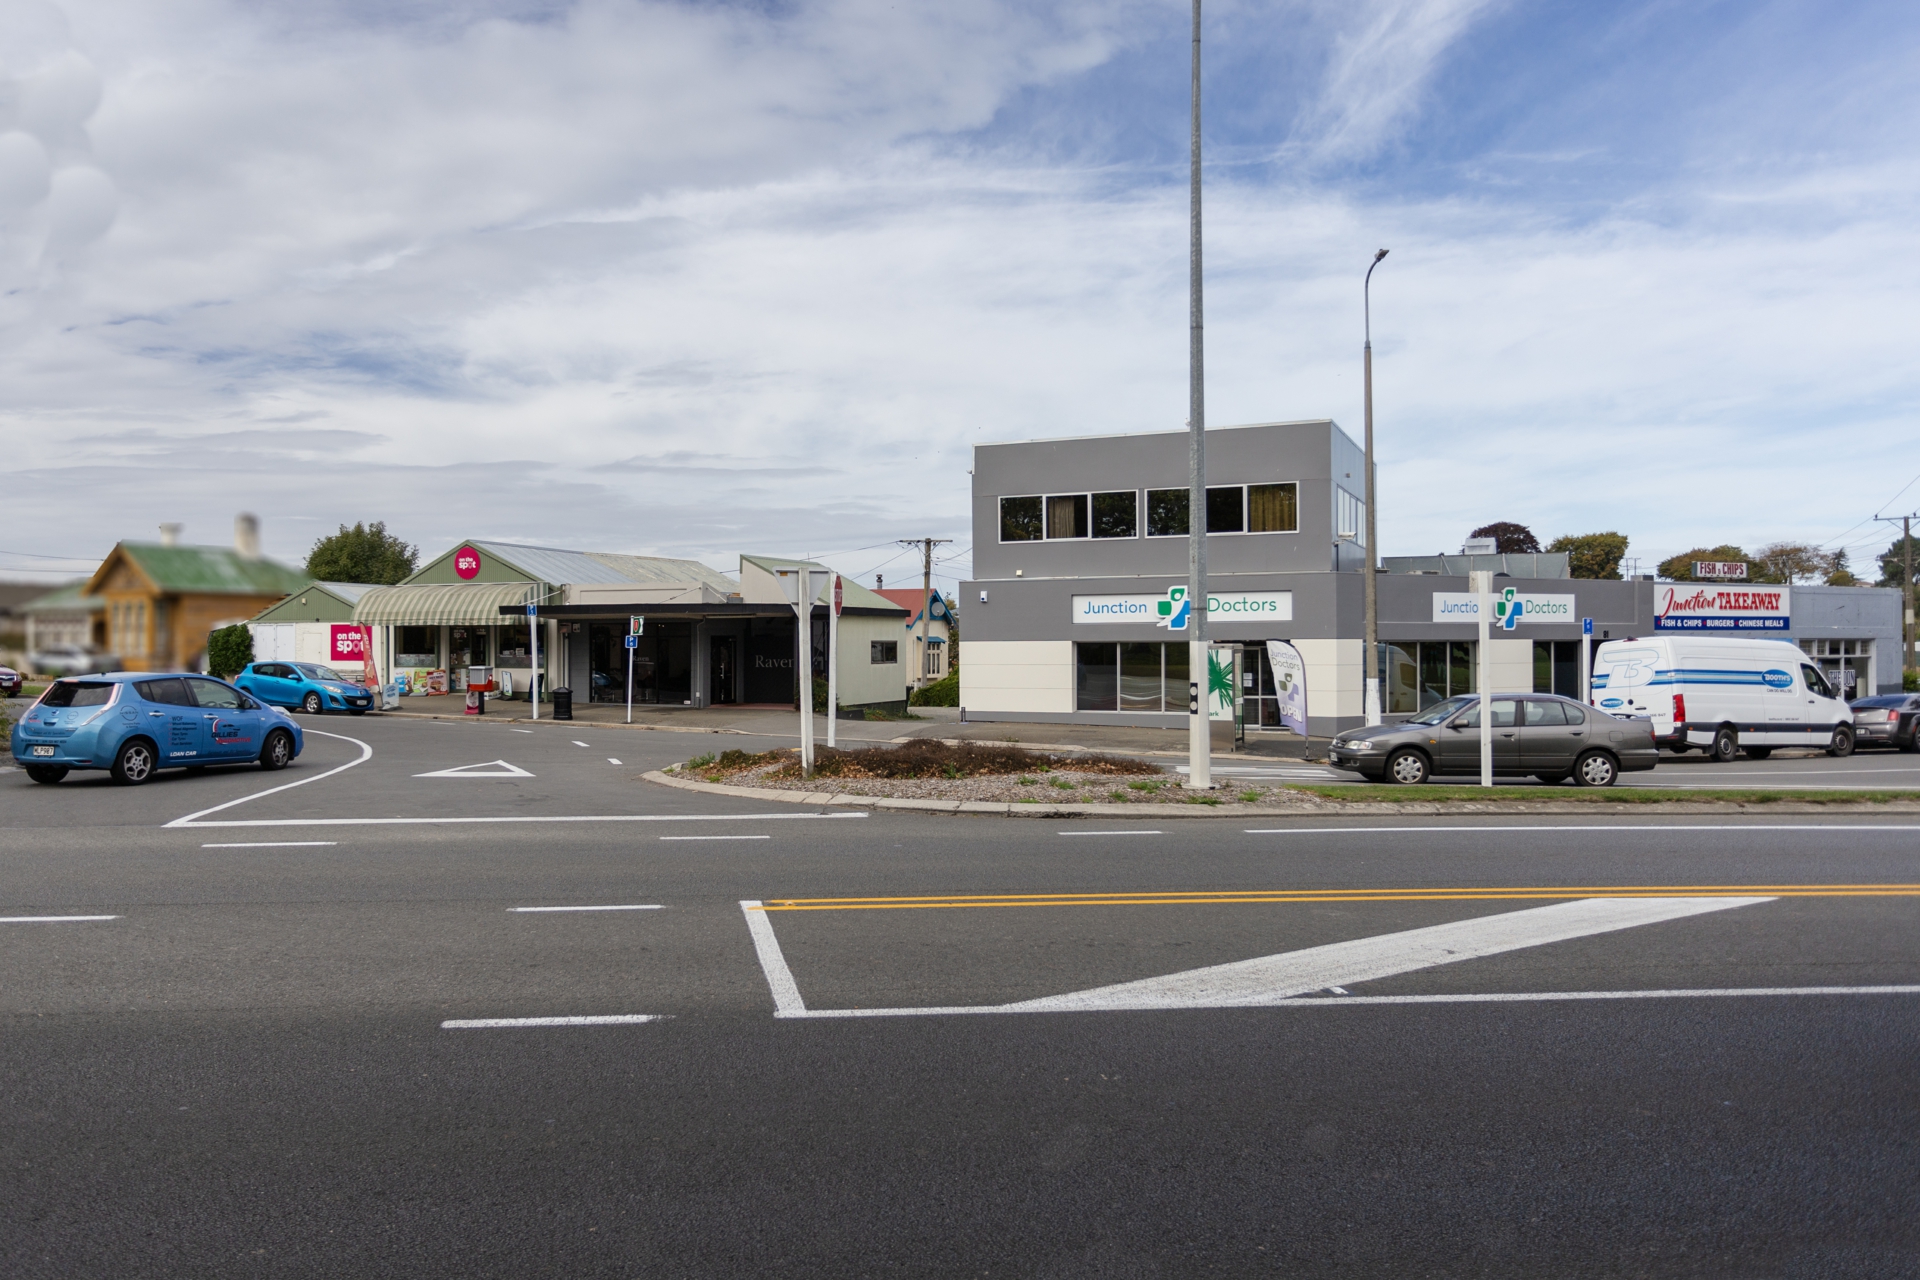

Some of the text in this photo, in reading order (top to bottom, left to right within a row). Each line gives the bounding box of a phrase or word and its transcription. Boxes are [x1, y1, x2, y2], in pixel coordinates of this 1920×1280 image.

[458, 560, 477, 570] spot
[1700, 562, 1716, 575] FISH
[1722, 563, 1744, 575] CHIPS
[1083, 596, 1277, 615] Junction Doctors
[1440, 600, 1568, 614] Junctio Doctors
[1659, 587, 1781, 619] Junction TAKEAWAY
[1661, 619, 1784, 627] FISH & CHIPS BURGERS CHINESE MEALS
[348, 631, 362, 640] the
[1270, 649, 1298, 661] Junction
[1271, 657, 1300, 671] Doctors
[1280, 704, 1303, 723] OPEN
